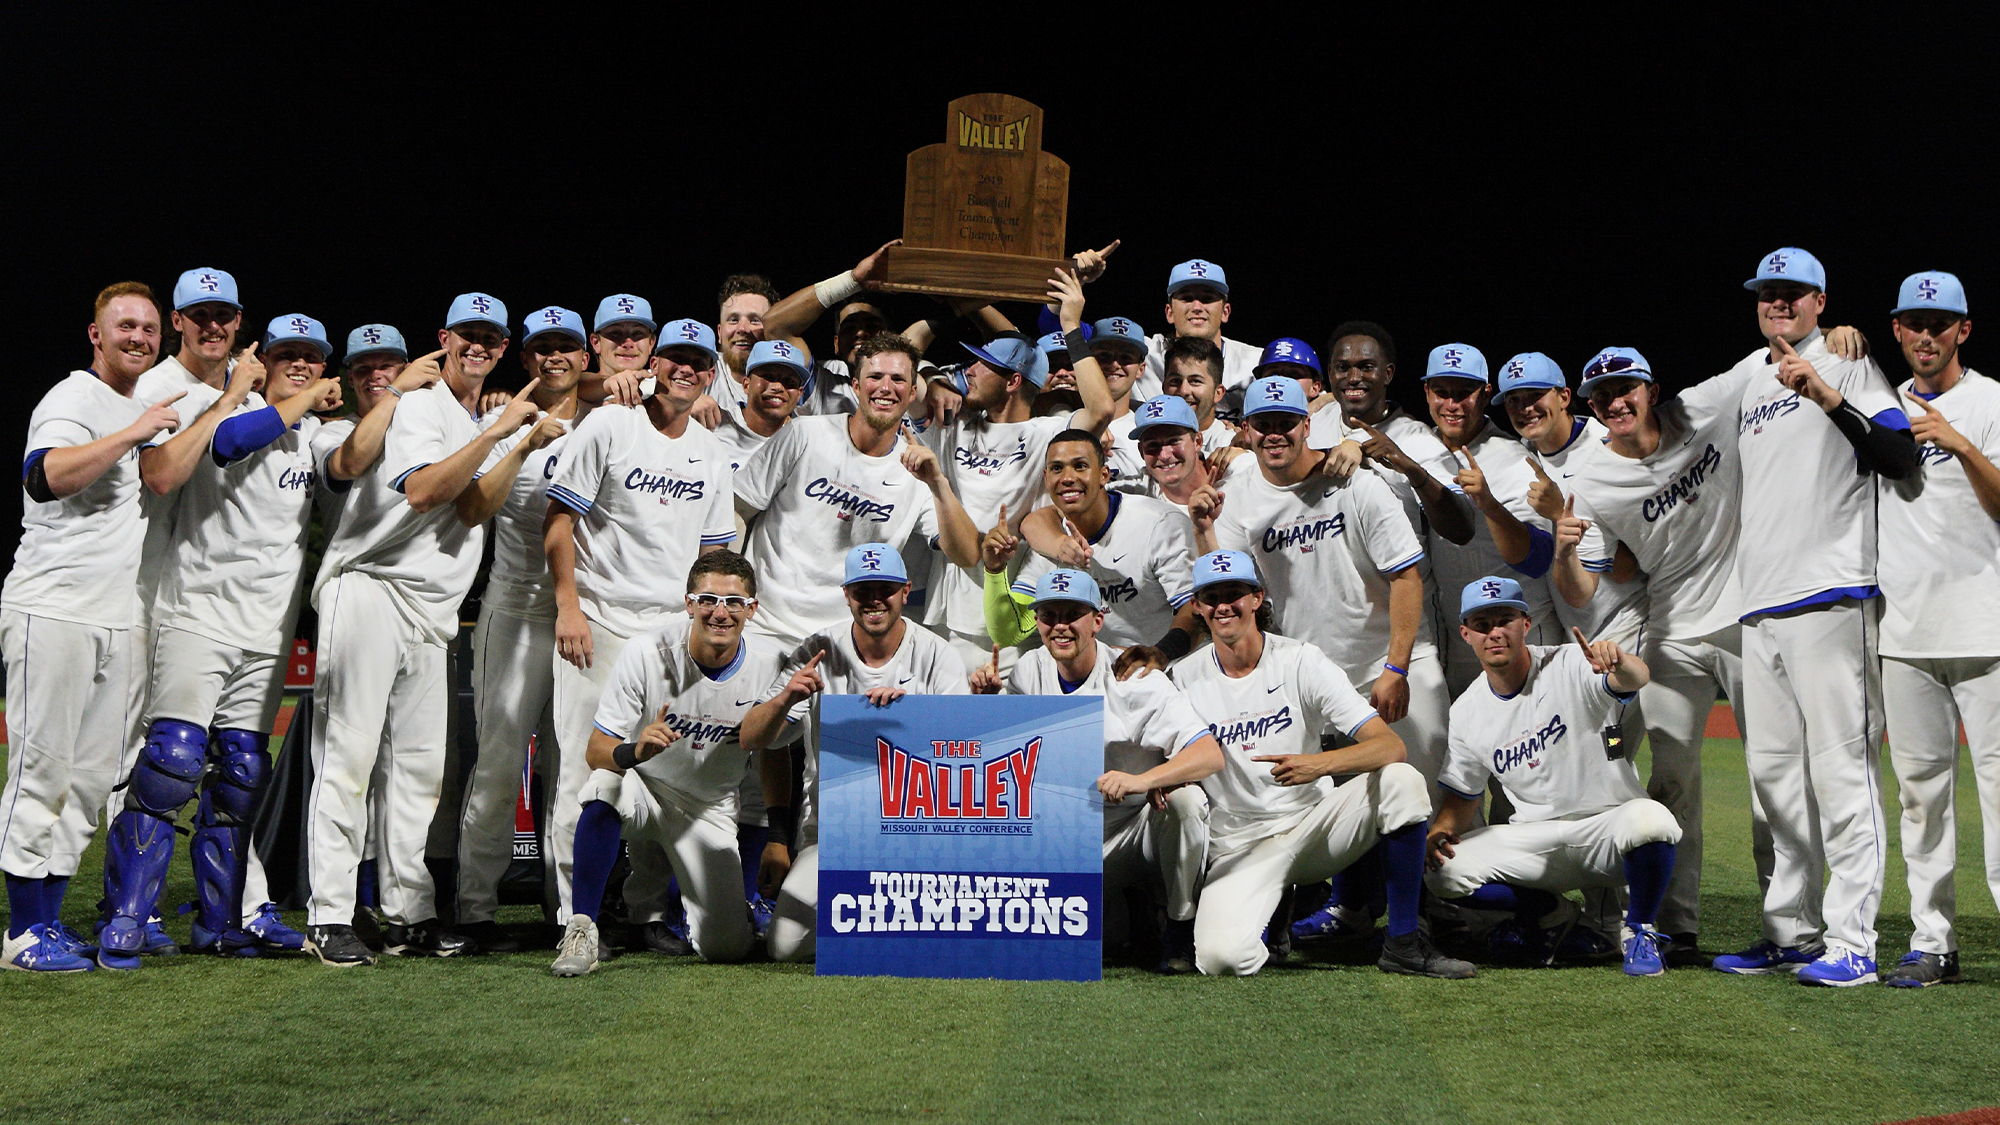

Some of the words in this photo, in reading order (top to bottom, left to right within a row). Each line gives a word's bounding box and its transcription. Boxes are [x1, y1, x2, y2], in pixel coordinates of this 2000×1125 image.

[957, 109, 1032, 151] VALLEY
[957, 209, 1020, 226] Tournament
[967, 194, 1012, 209] Baseball
[624, 468, 705, 501] CHAMPS
[805, 477, 895, 523] CHAMPS
[1643, 443, 1721, 522] CHAMPS
[1262, 512, 1345, 553] CHAMPS
[1209, 706, 1293, 747] CHAMPS
[1493, 714, 1567, 774] CHAMPS
[931, 740, 981, 758] THE
[876, 735, 1042, 819] VALLEY
[880, 824, 928, 834] MISSOURI
[932, 824, 966, 834] VALLEY
[969, 824, 1033, 834] CONFERENCE
[870, 871, 1050, 899] TOURNAMENT
[831, 892, 1089, 937] CHAMPIONS
